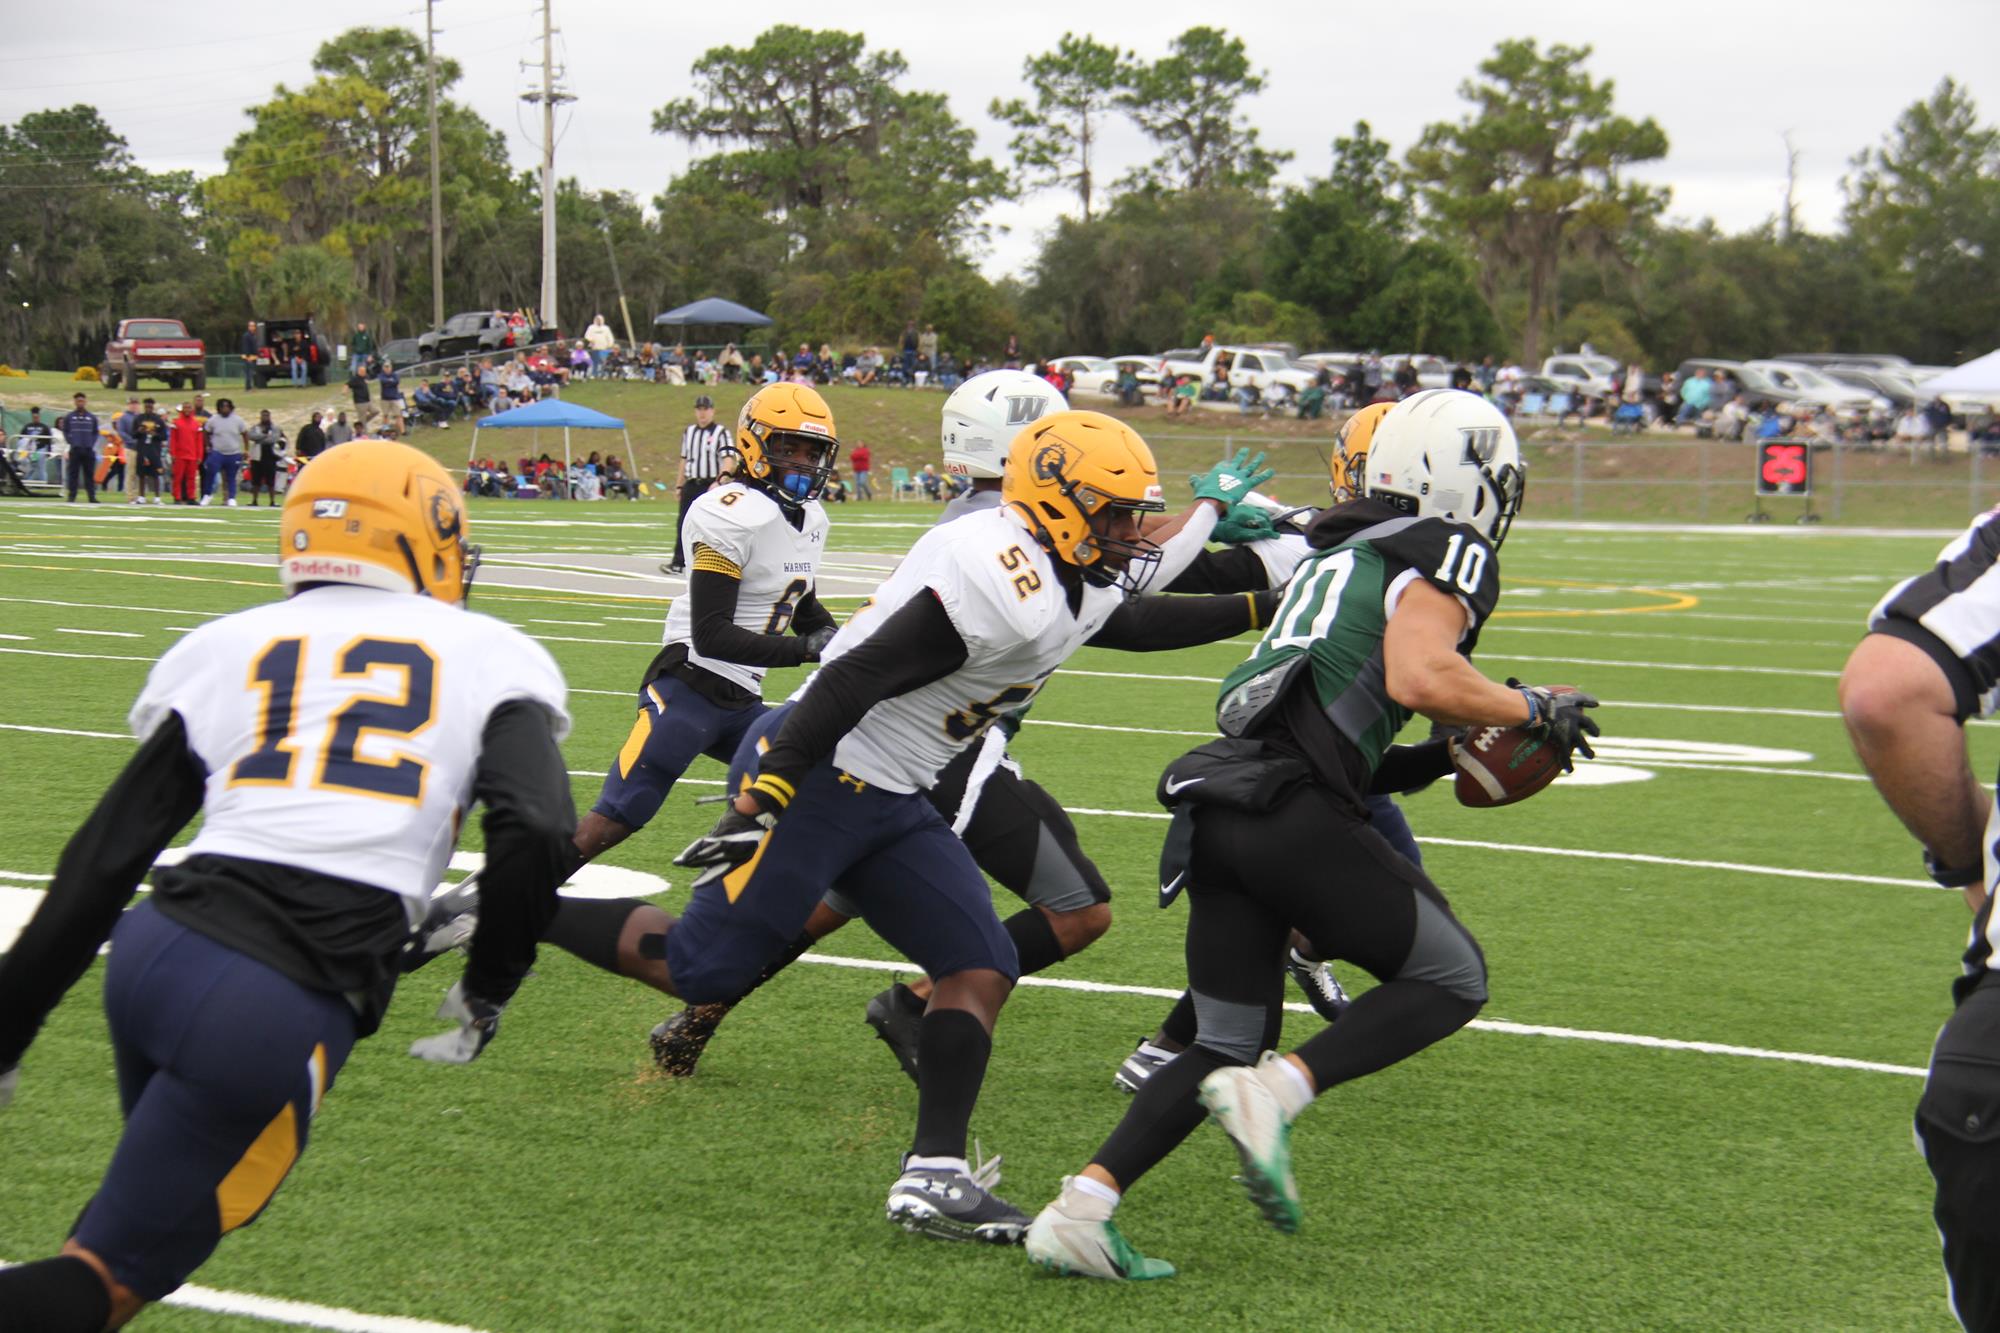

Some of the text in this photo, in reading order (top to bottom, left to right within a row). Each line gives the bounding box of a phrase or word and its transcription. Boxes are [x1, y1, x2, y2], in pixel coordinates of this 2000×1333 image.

[720, 490, 745, 507] 6
[1421, 482, 1429, 495] 8
[999, 543, 1042, 602] 52
[1434, 534, 1487, 594] 10
[767, 575, 808, 637] 6
[225, 633, 442, 810] 12
